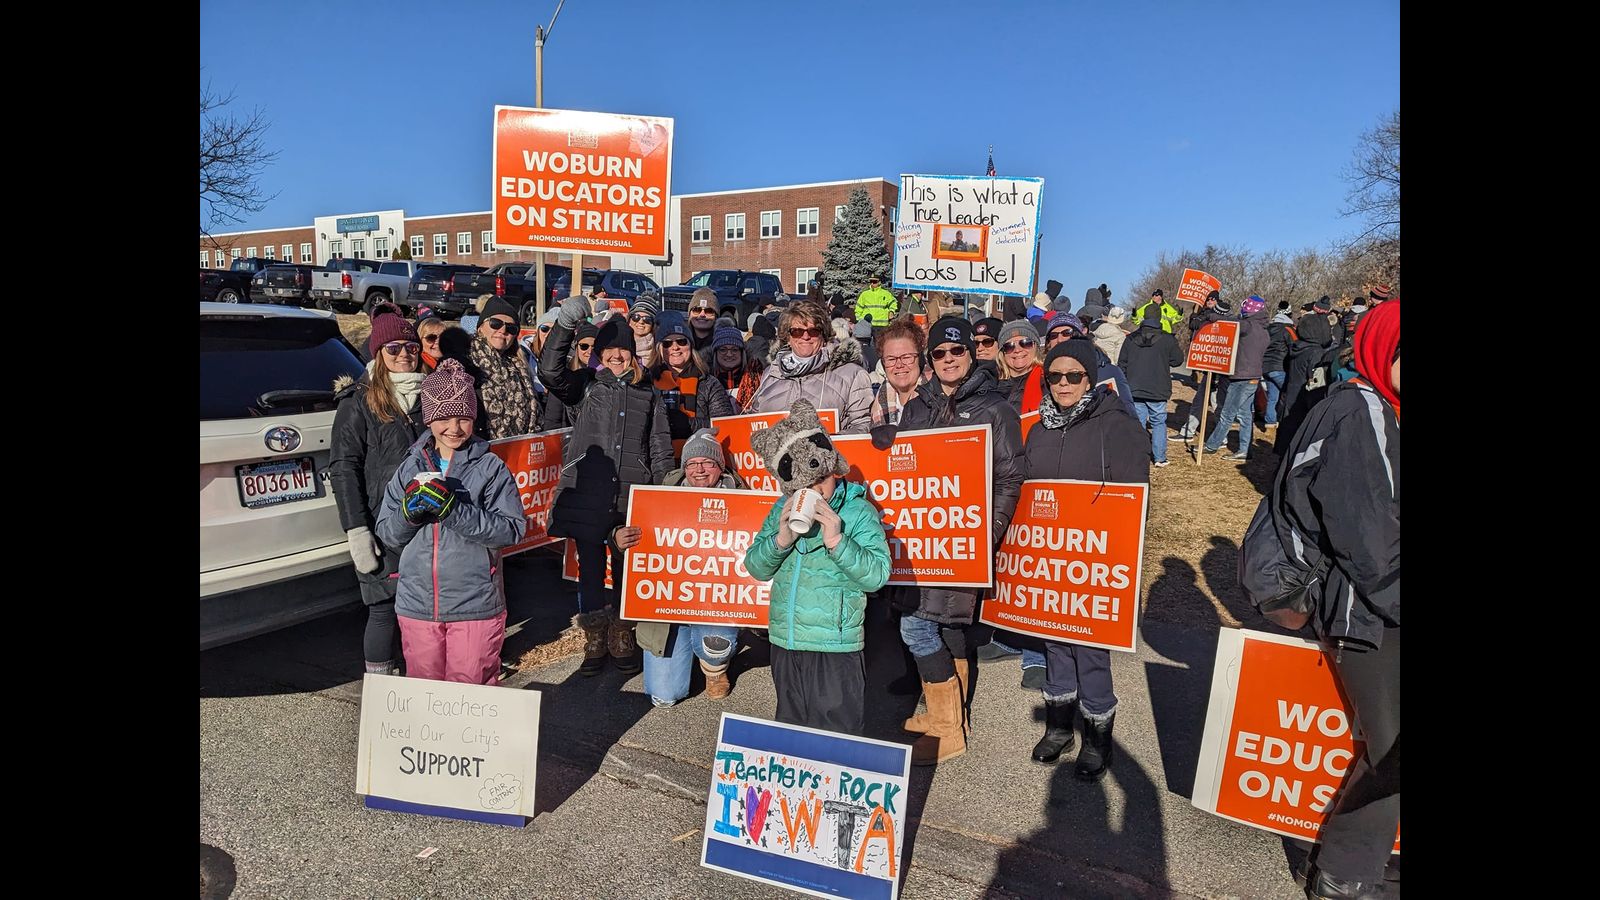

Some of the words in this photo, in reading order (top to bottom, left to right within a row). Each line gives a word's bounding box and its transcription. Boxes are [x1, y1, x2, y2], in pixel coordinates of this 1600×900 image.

[523, 150, 642, 178] WOBURN
[501, 176, 661, 208] EDUCATORS
[901, 176, 936, 202] This
[948, 184, 964, 202] is
[973, 180, 1018, 205] what
[1023, 192, 1035, 206] a
[506, 205, 546, 228] ON
[552, 208, 654, 234] STRIKE!
[910, 202, 942, 222] True
[948, 204, 1000, 226] Leader
[528, 234, 632, 248] #NOMOREBUSINESSASUSUAL
[904, 256, 957, 281] Looks
[970, 254, 1016, 284] Like!
[1192, 344, 1231, 355] EDUCATORS
[1199, 334, 1228, 344] WOBURN
[1192, 353, 1202, 361] ON
[1204, 354, 1229, 366] STRIKE!
[752, 422, 768, 432] WTA
[530, 442, 544, 452] WTA
[891, 443, 913, 456] WTA
[244, 472, 288, 496] 8036
[292, 469, 311, 490] NF
[286, 492, 316, 501] TOYOTA
[702, 498, 726, 510] WTA
[1034, 489, 1055, 502] WTA
[880, 505, 982, 530] CATORS
[654, 527, 758, 550] WOBUR
[890, 536, 976, 560] TRIKE!
[1006, 524, 1108, 554] WOBURN
[632, 552, 751, 578] EDUCATO
[636, 580, 673, 600] ON
[678, 580, 770, 606] STRIKE
[1014, 584, 1120, 622] STRIKE!
[655, 608, 757, 619] #NOMOREBUSINESSASUSUAL
[998, 612, 1094, 636] #NOMOREBUSINESSASUSUAL
[386, 690, 412, 714] Our
[426, 692, 498, 718] Teachers
[380, 722, 411, 740] Need
[420, 724, 445, 742] Our
[462, 726, 500, 753] City's
[400, 746, 484, 778] SUPPORT
[488, 785, 517, 806] CONTRACT
[489, 782, 507, 797] FAIR
[839, 771, 900, 814] ROCK
[1238, 770, 1303, 808] ON
[713, 782, 740, 838] I
[780, 797, 896, 878] WTA
